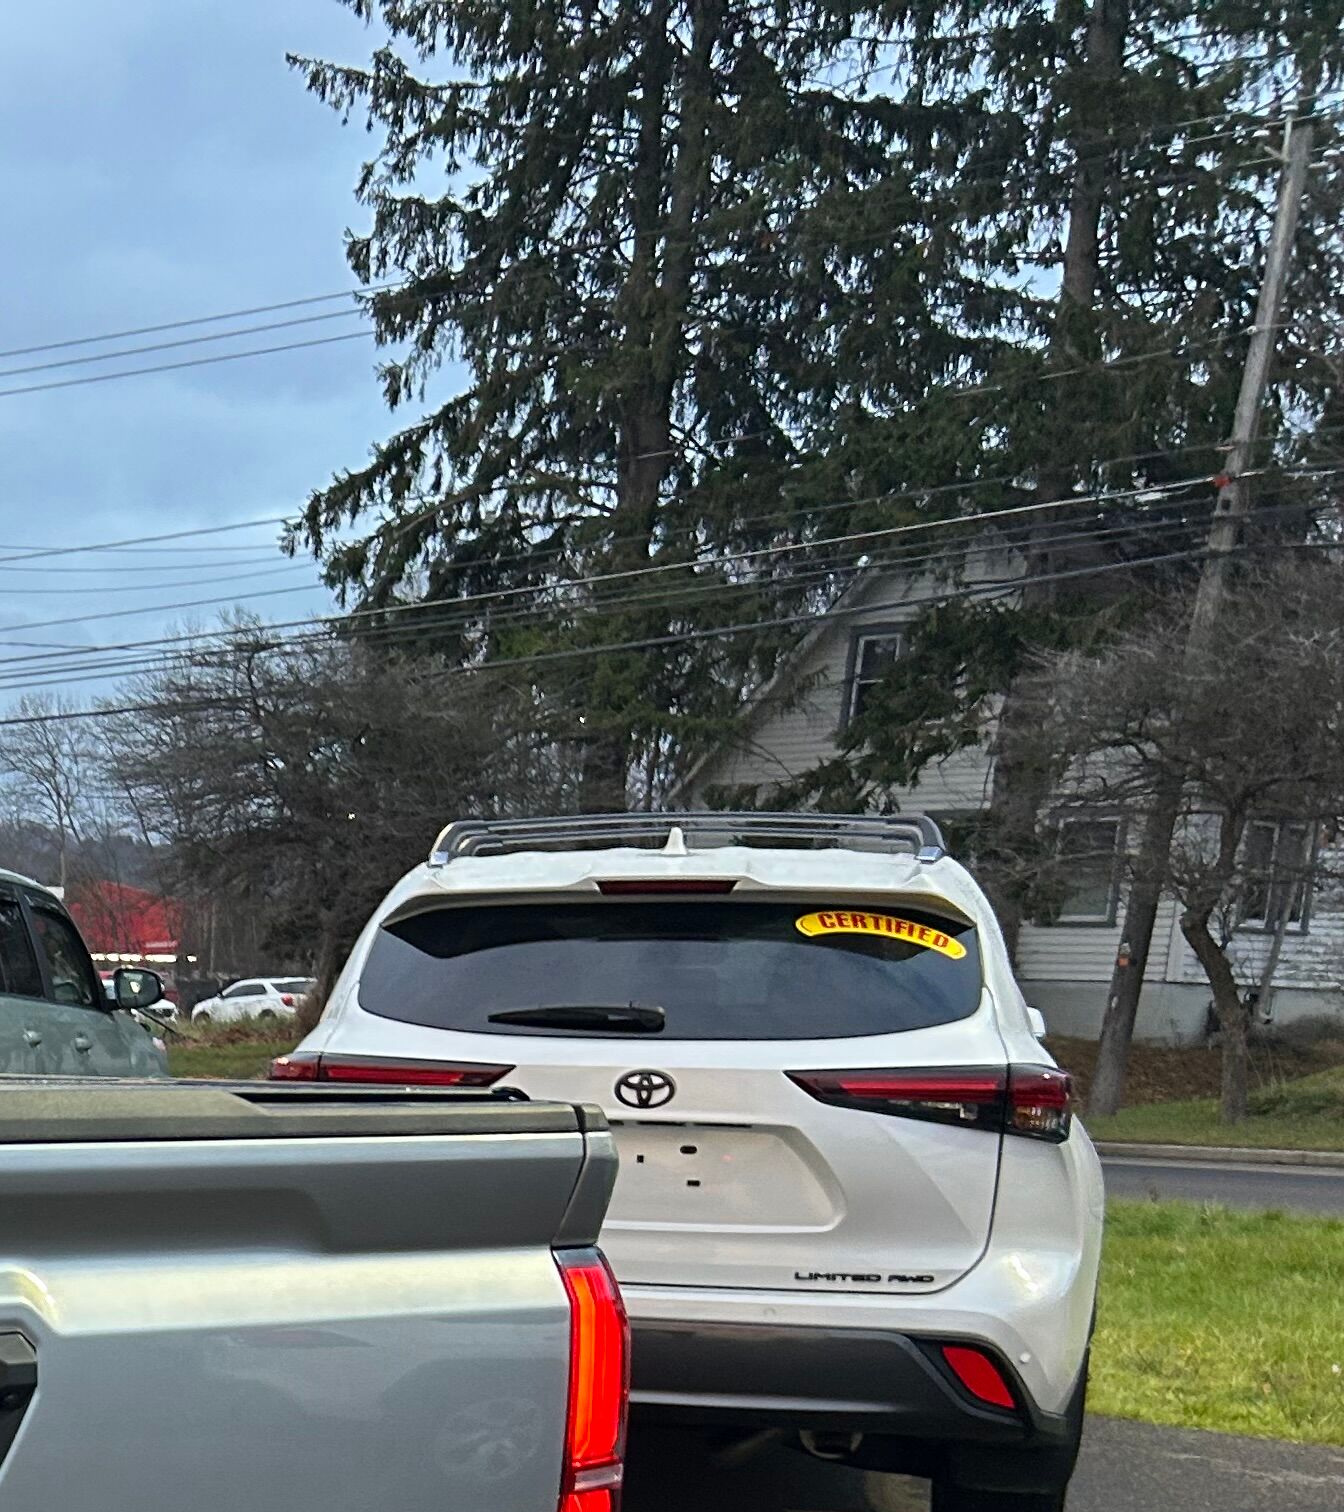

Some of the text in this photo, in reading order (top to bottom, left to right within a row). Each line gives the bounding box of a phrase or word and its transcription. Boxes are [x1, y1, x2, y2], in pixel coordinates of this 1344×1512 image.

[817, 911, 950, 949] CERTIFIED
[794, 1271, 935, 1283] LIMITED AWD
